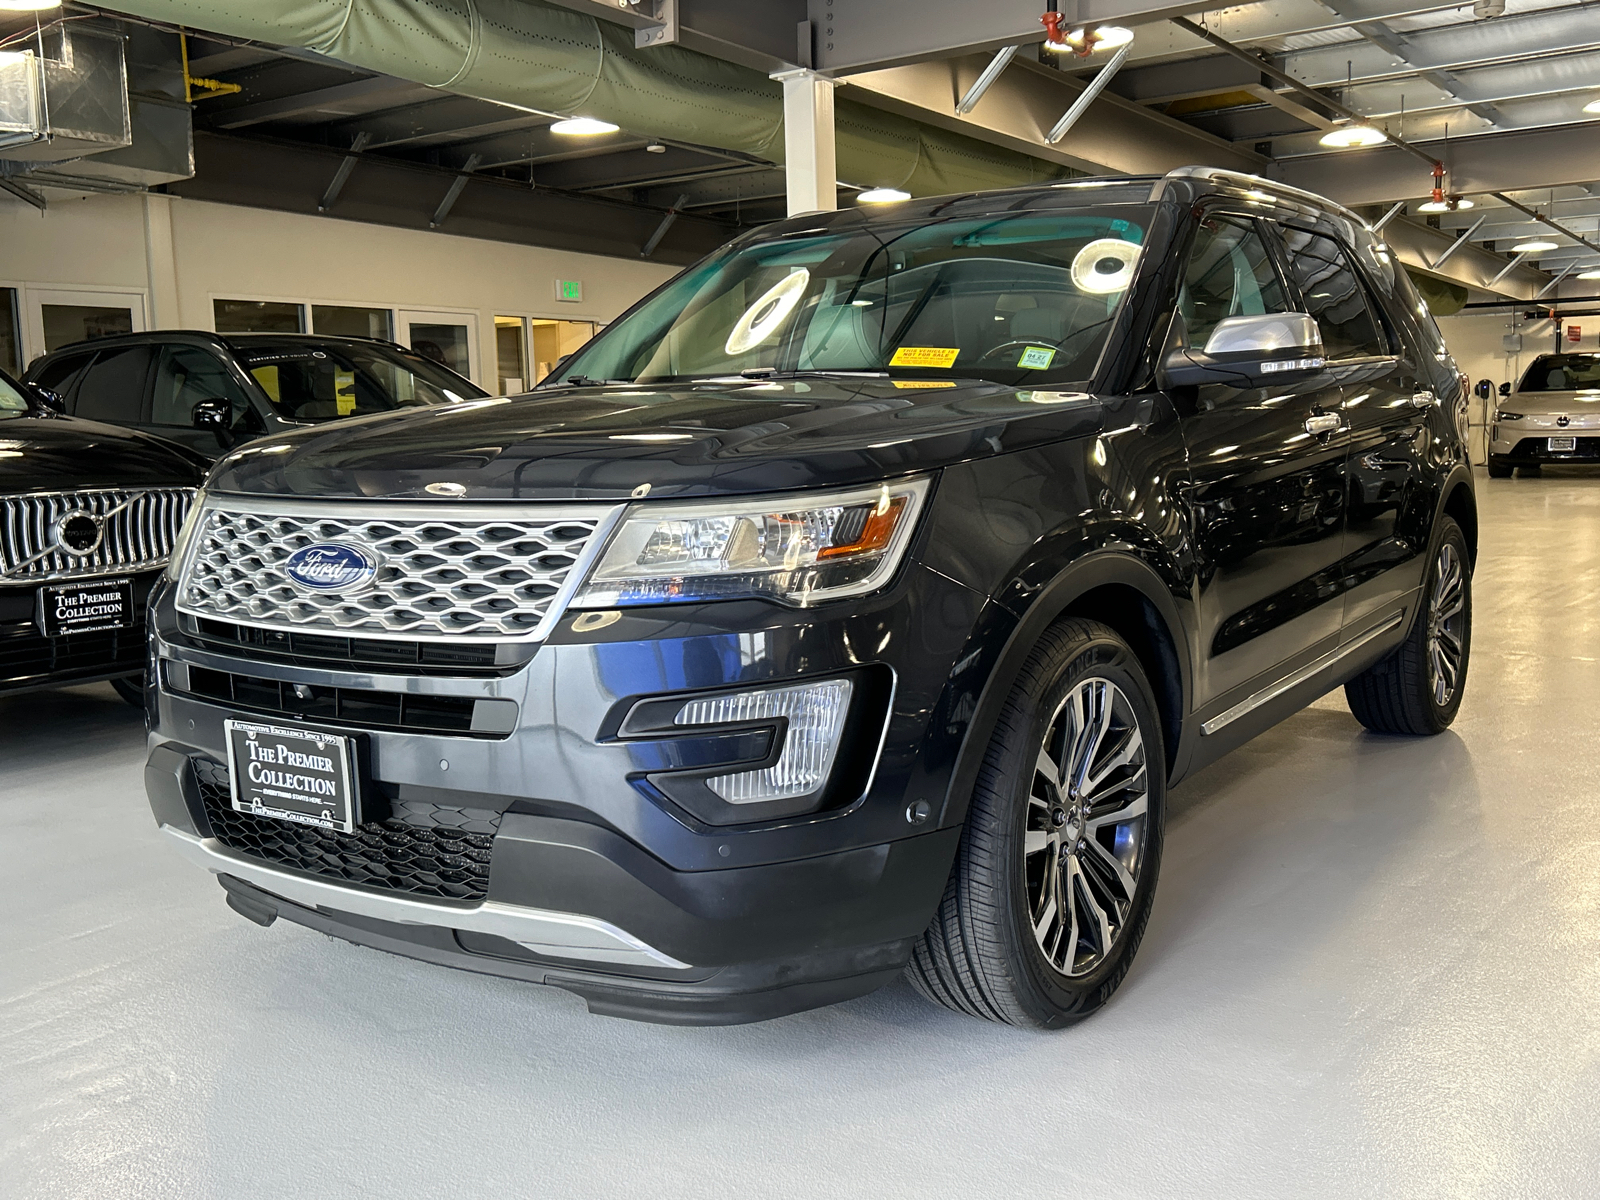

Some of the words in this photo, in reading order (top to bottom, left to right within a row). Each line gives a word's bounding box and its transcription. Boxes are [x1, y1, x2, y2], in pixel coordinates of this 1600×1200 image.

[563, 281, 579, 298] EXIT
[296, 548, 349, 579] Ford
[55, 595, 78, 607] THE
[79, 592, 122, 604] PREMIER
[56, 603, 122, 619] COLLECTION
[321, 734, 336, 744] 1995
[245, 740, 276, 763] THE
[276, 744, 334, 773] PREMIER
[248, 762, 336, 796] COLLECTION
